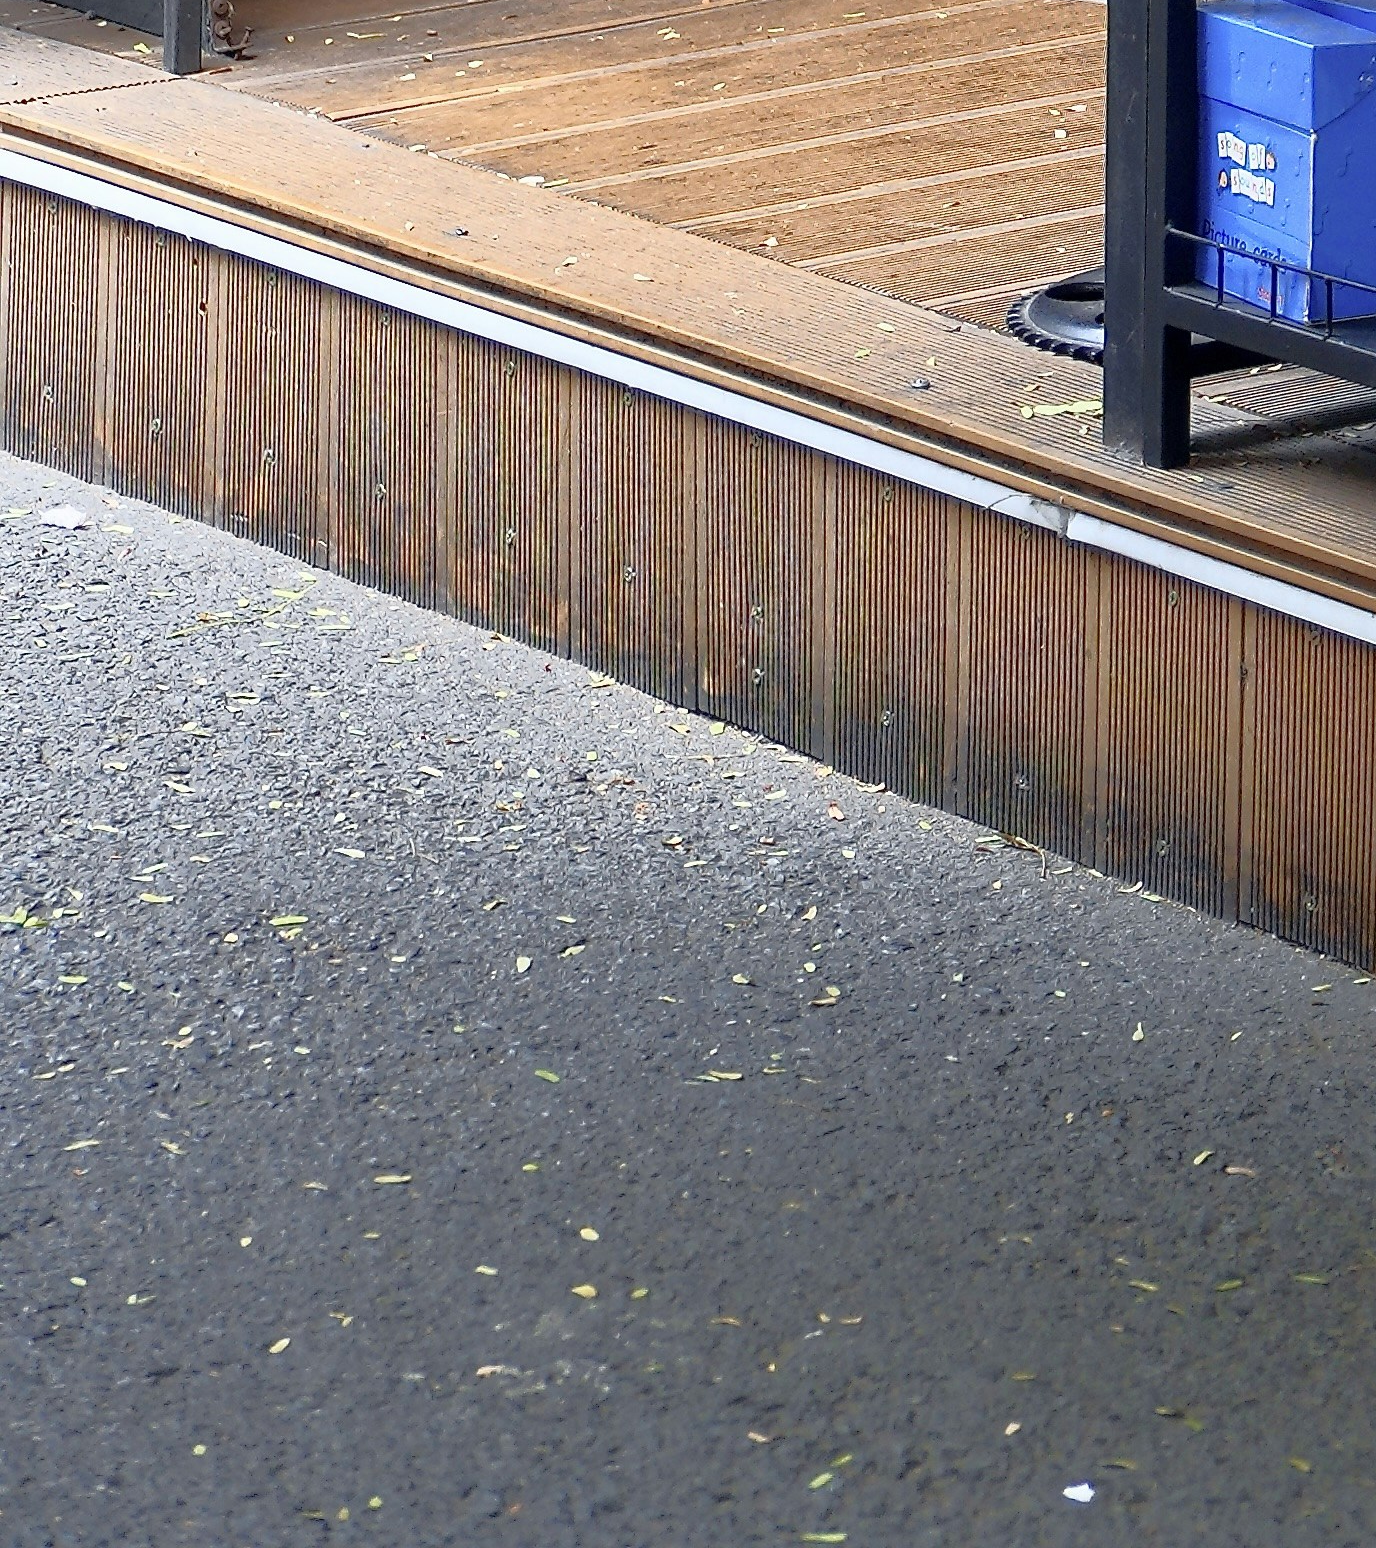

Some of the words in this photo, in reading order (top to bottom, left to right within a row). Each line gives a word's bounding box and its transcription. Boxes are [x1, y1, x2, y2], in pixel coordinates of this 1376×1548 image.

[1219, 135, 1245, 162] song
[1251, 145, 1264, 167] of
[1231, 174, 1273, 198] sounds
[1202, 218, 1248, 254] Picture
